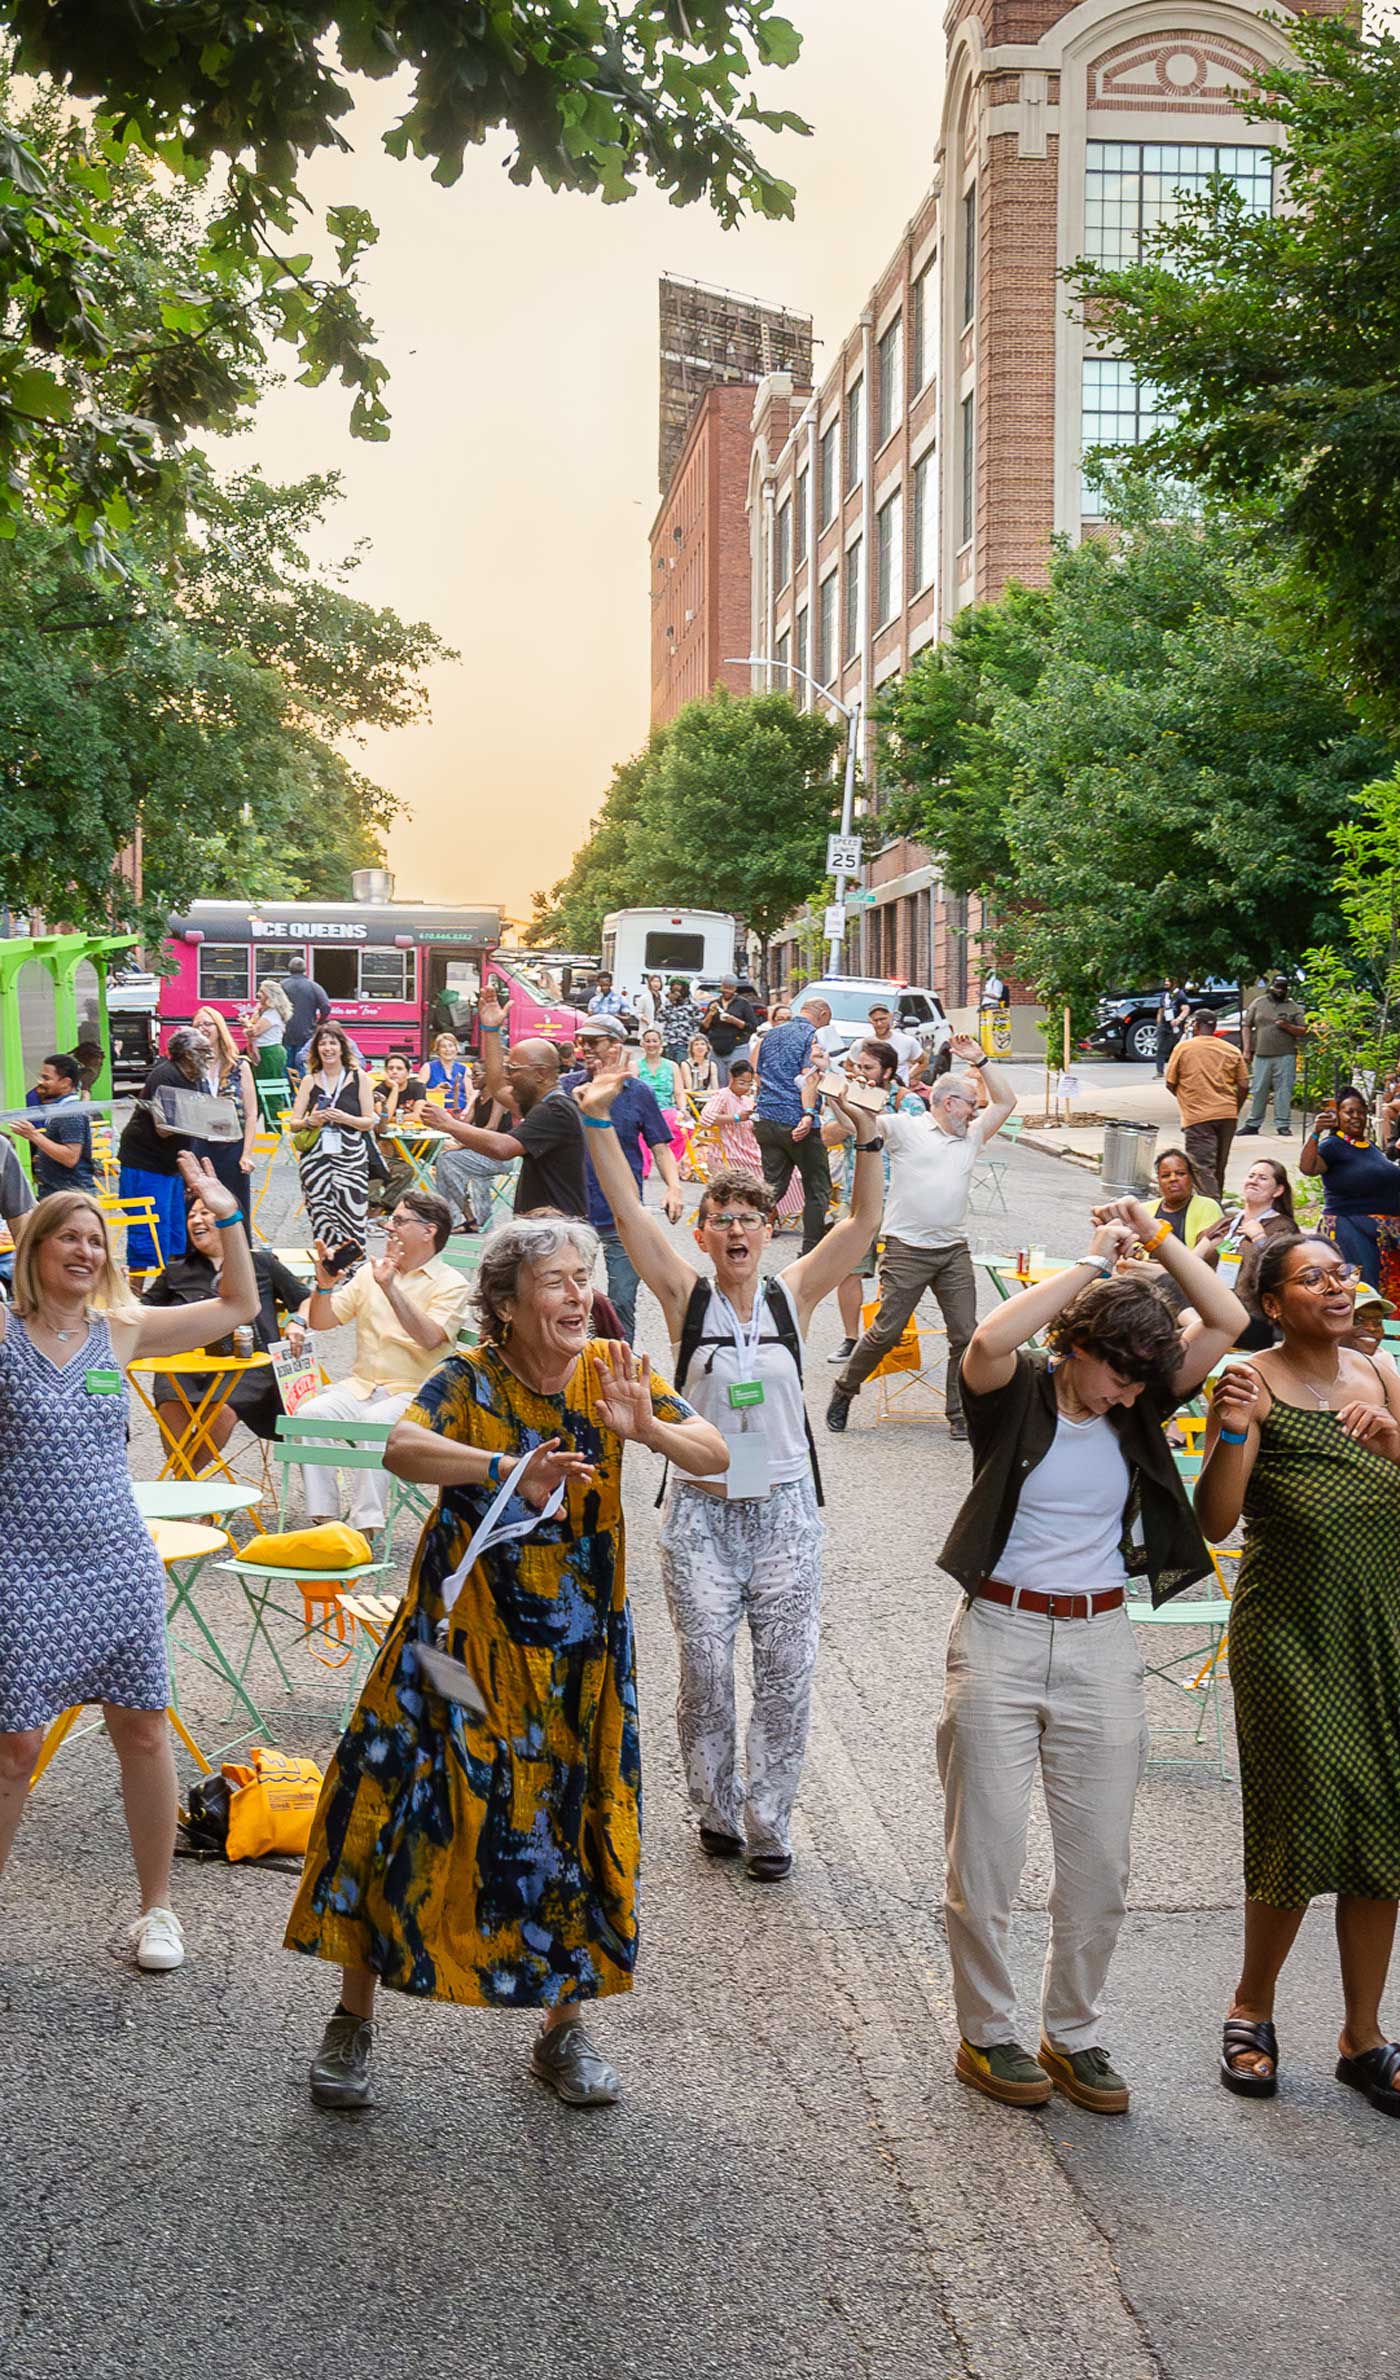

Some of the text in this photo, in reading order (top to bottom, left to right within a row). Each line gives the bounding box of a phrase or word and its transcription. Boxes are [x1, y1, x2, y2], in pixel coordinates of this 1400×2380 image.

[833, 837, 859, 846] SPEED
[833, 845, 855, 853] LIMIT
[832, 853, 856, 868] 25
[251, 920, 368, 939] ICE QUEENS
